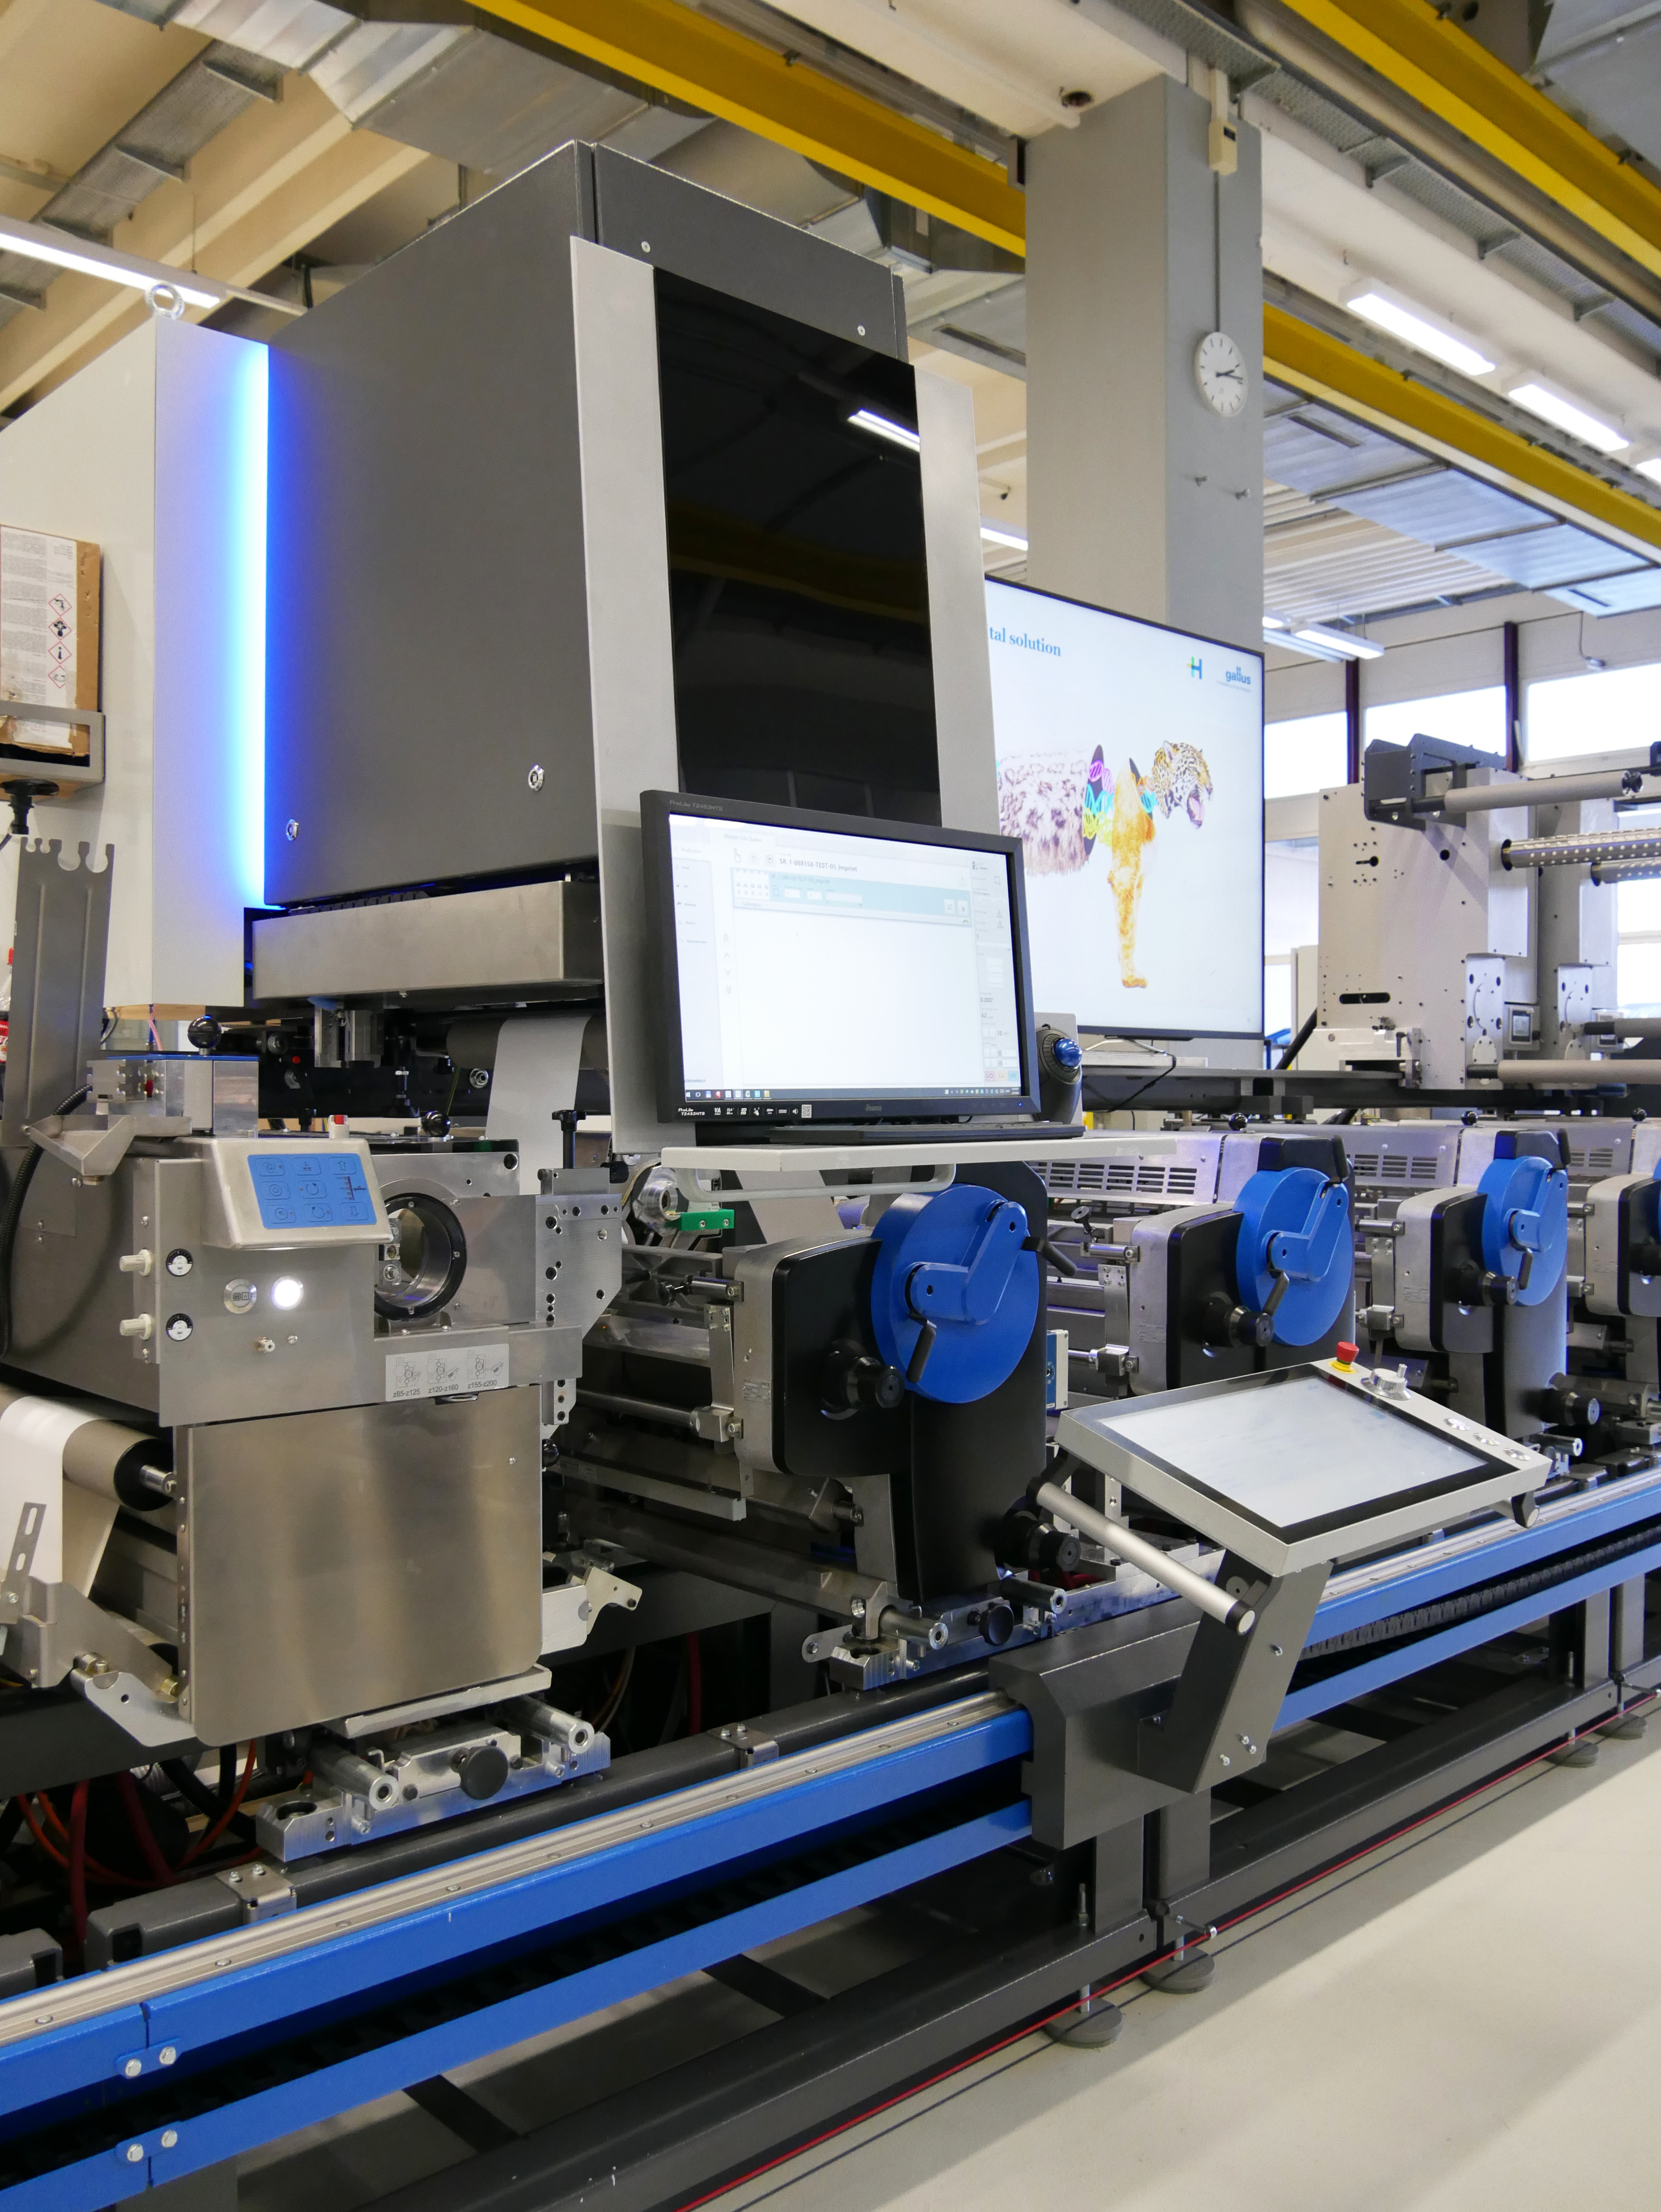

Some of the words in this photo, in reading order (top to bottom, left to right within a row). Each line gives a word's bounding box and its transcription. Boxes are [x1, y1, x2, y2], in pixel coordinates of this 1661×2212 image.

[1009, 632, 1061, 657] solution
[1226, 666, 1251, 685] gallus
[779, 858, 857, 872] SR_1-088158-TEST-05_Imprint
[428, 1384, 459, 1394] z120-z160
[467, 1380, 497, 1389] z155-z200
[393, 1388, 421, 1397] z85-z125
